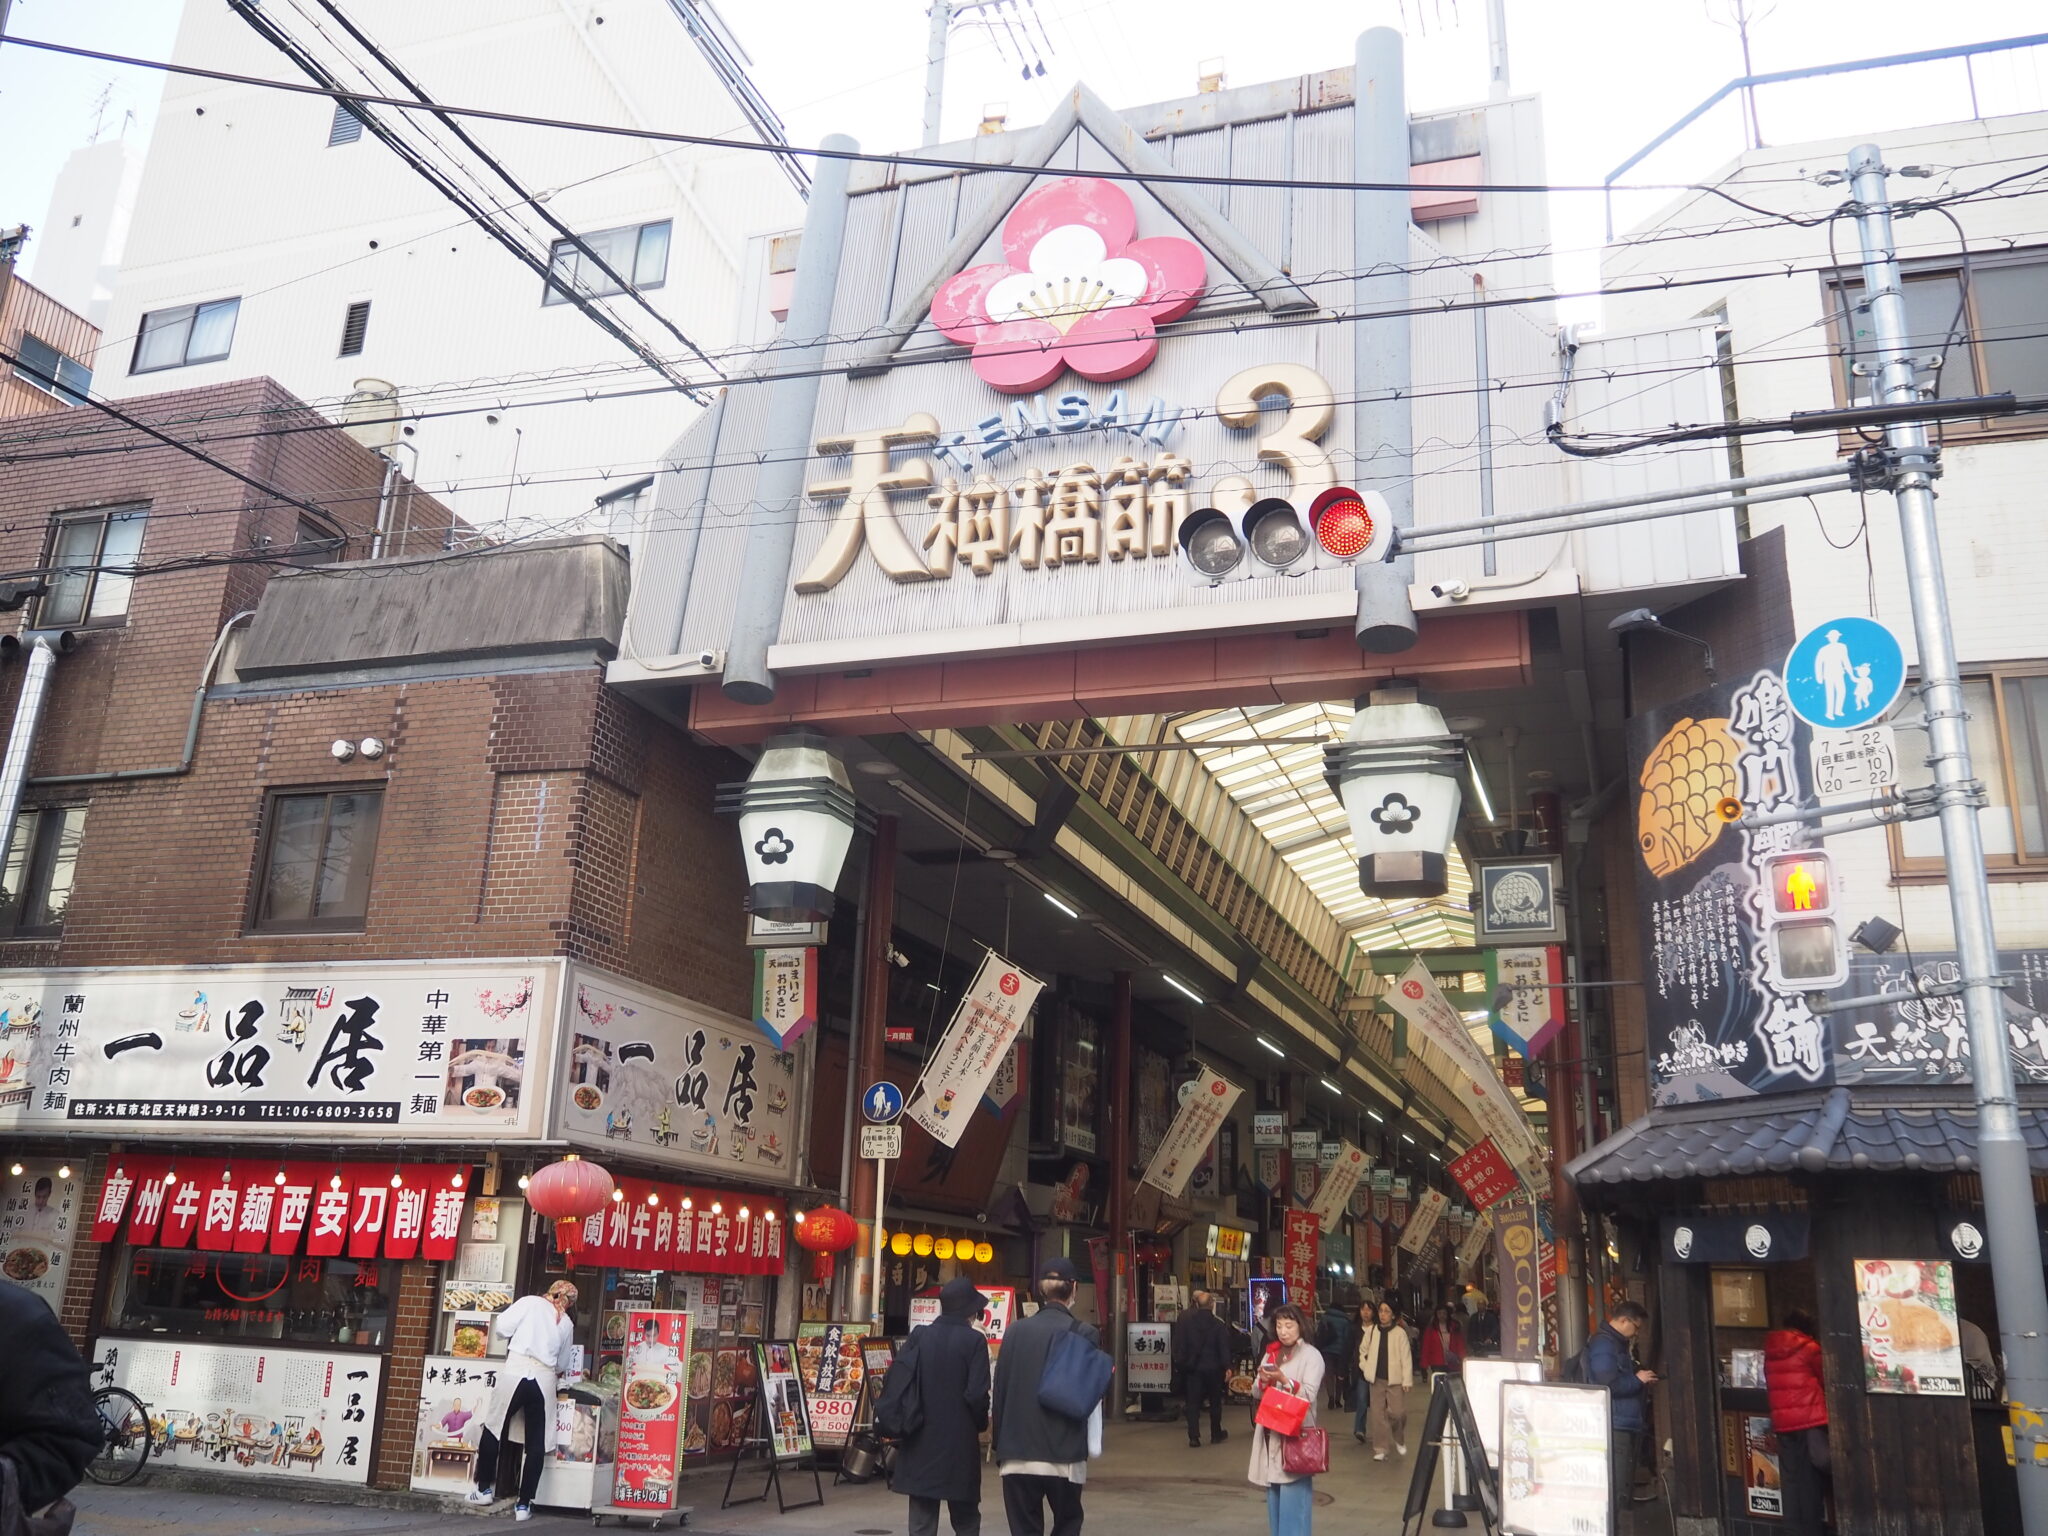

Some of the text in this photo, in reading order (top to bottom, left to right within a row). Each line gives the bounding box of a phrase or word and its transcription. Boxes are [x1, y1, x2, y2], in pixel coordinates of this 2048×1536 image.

[933, 389, 1183, 471] TENSAN
[1822, 741, 1829, 753] 7
[1862, 732, 1880, 746] 22
[1825, 779, 1842, 792] 20
[1869, 771, 1888, 784] 22
[1826, 766, 1834, 778] 7
[1867, 758, 1881, 771] 10
[776, 974, 787, 1018] おおきに
[790, 970, 799, 1003] まいど
[43, 994, 86, 1111] 蘭州牛肉麺
[103, 996, 384, 1094] 一品居
[410, 989, 449, 1114] 中華第一麺
[1656, 1040, 1749, 1073] 天然たいやき
[617, 1028, 758, 1125] 一品居
[260, 1105, 393, 1119] TEL:06-6809-3658
[918, 1114, 947, 1139] TENSAN
[1289, 1219, 1315, 1305] 中華料理
[336, 1370, 369, 1466] 一品居
